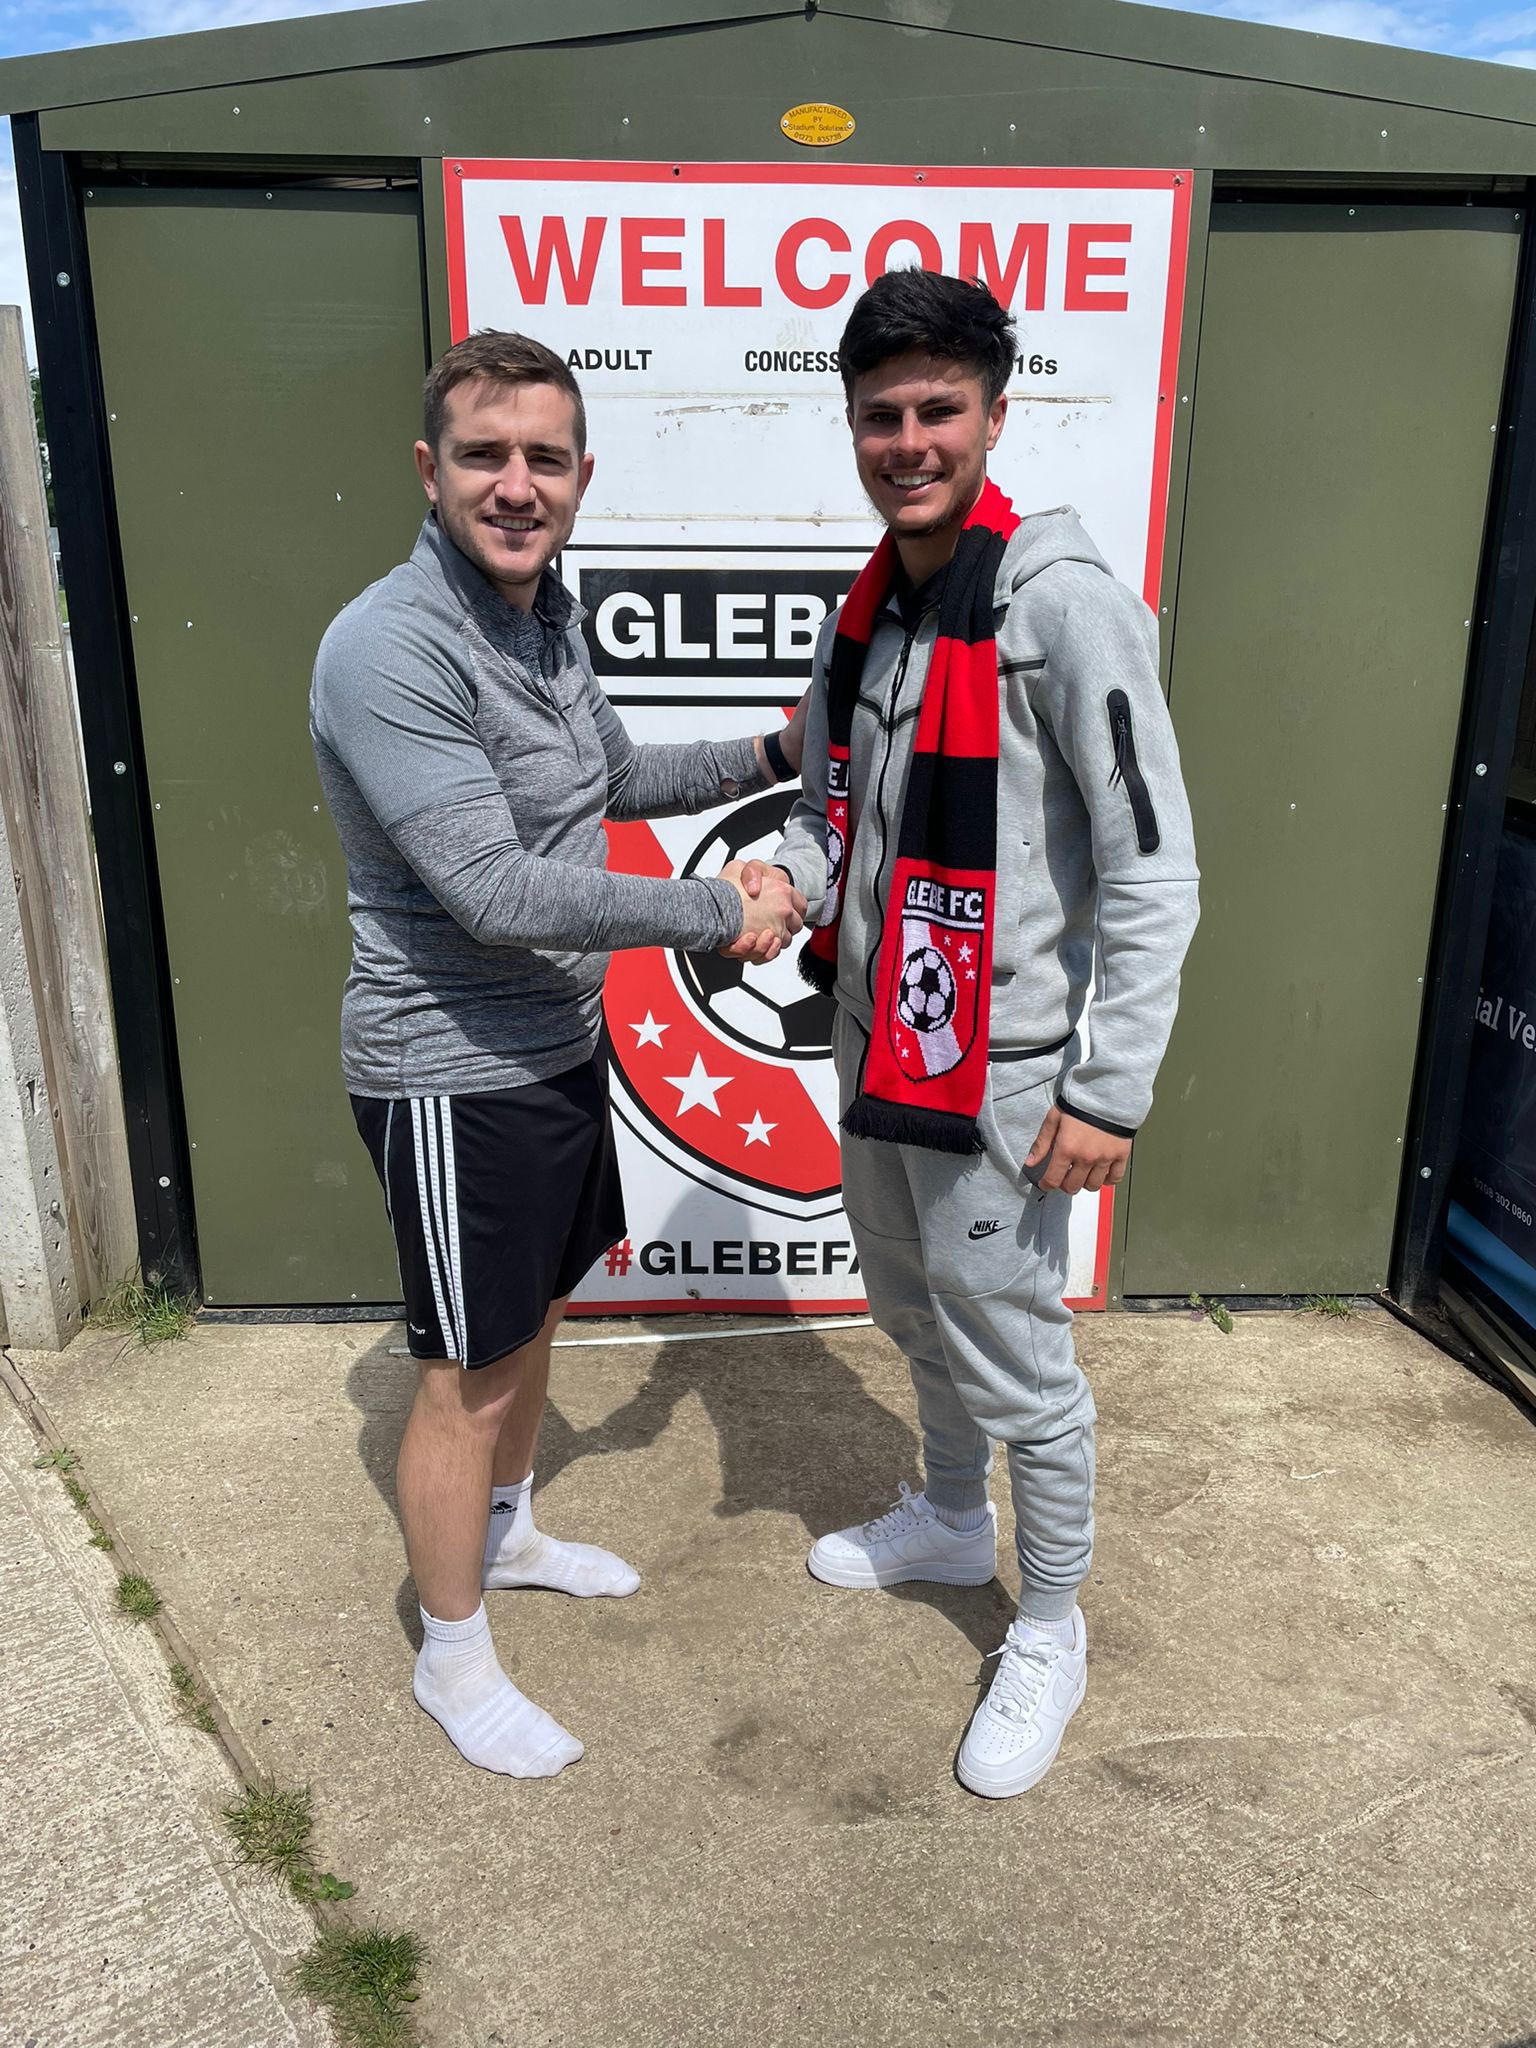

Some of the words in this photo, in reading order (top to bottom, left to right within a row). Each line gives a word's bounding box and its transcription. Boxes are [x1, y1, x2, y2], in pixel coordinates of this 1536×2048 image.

[789, 106, 848, 120] MANUFACTURED
[499, 215, 1133, 312] WELCOME
[567, 349, 653, 370] ADULT
[595, 591, 850, 659] GLEB
[950, 889, 983, 919] FC
[1495, 1191, 1511, 1211] 302
[1512, 1203, 1532, 1226] 0860
[973, 1220, 1000, 1232] NIKE
